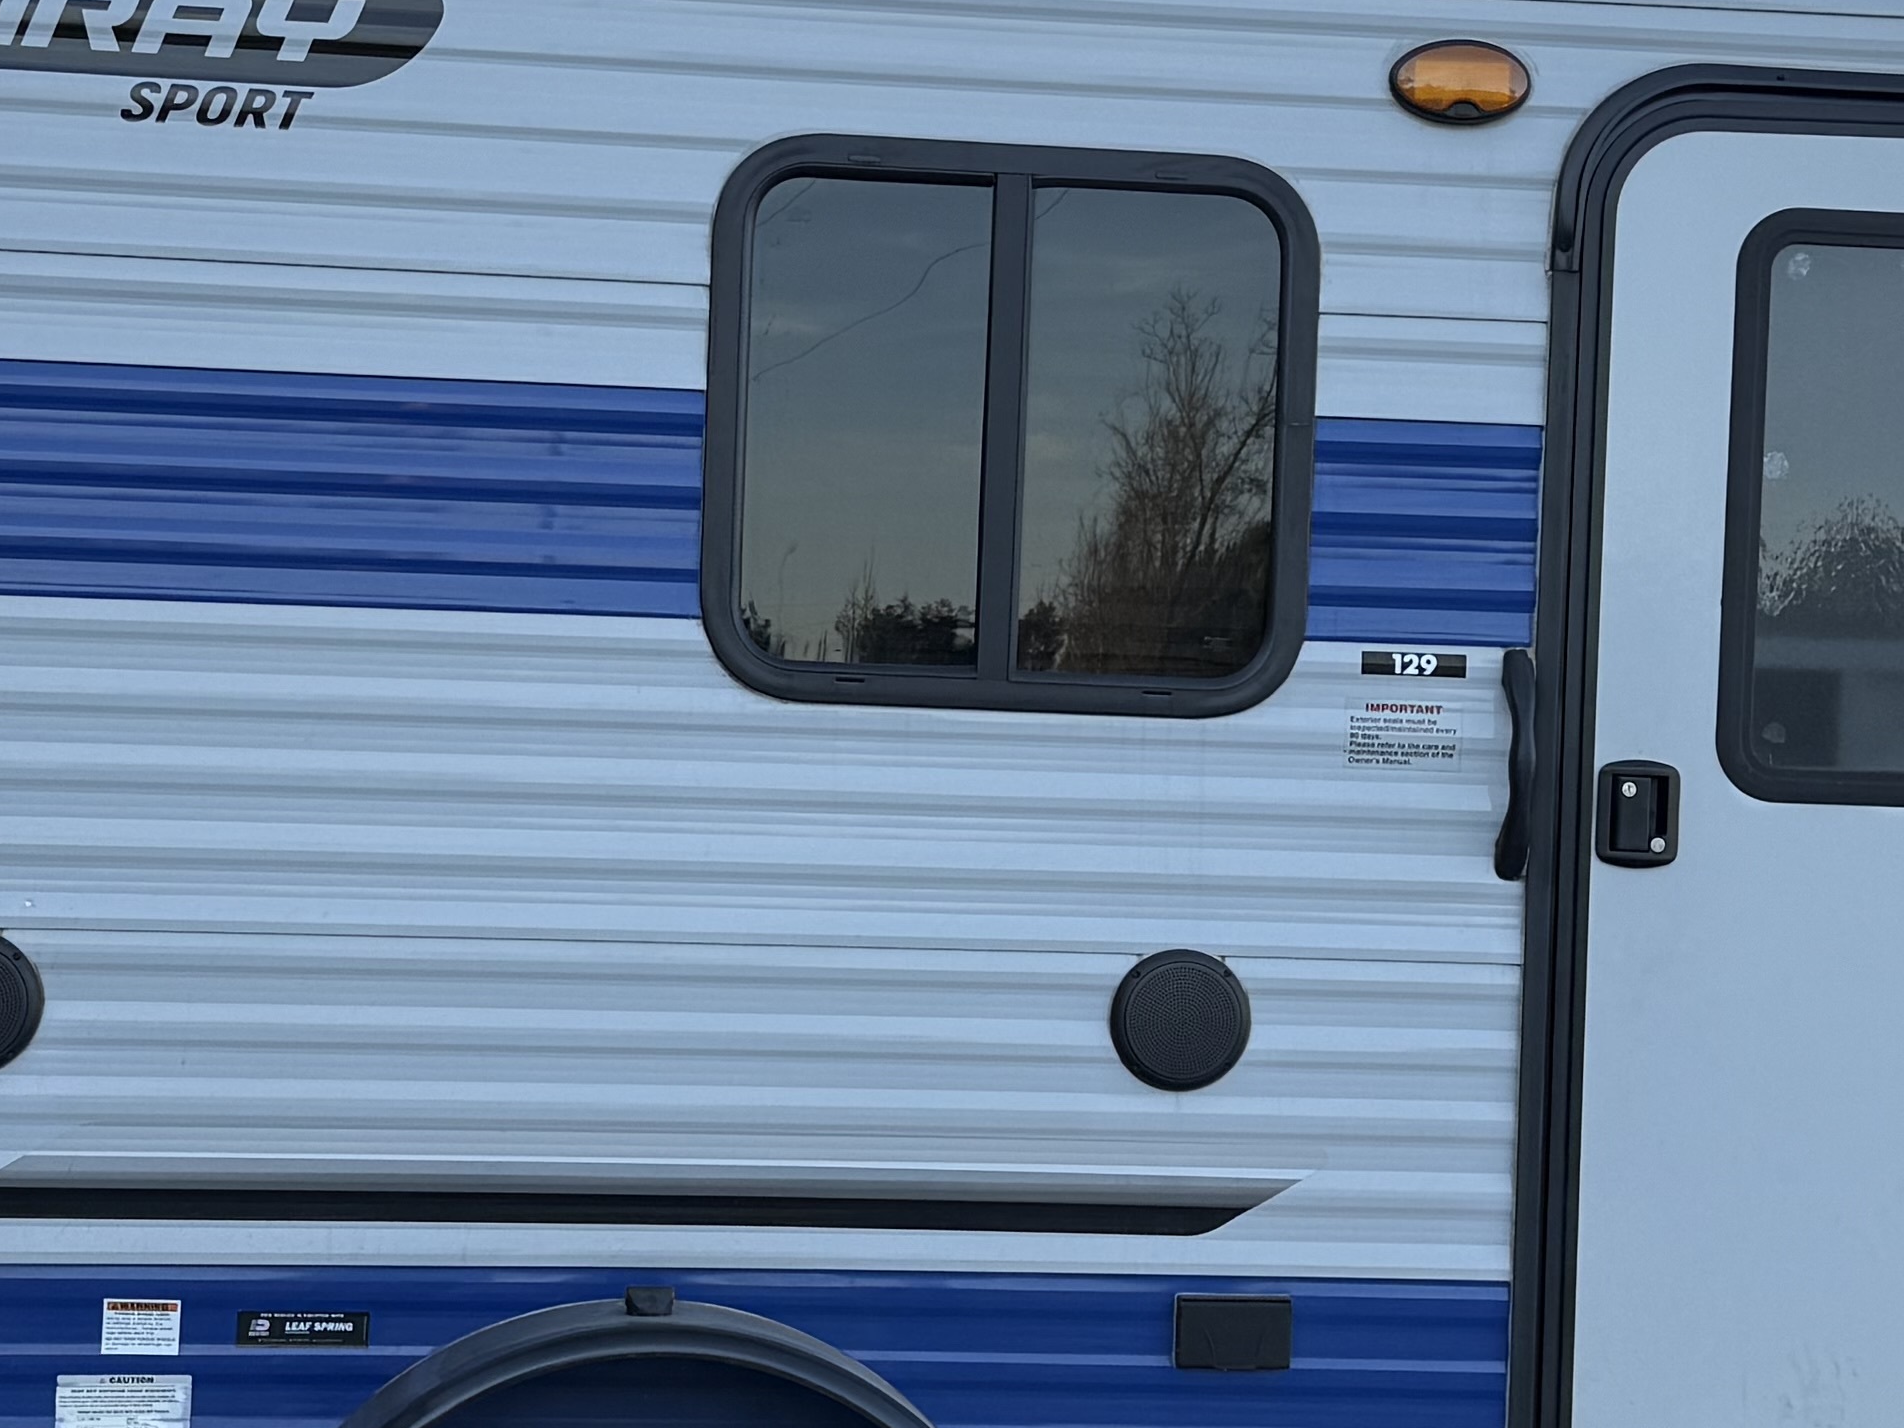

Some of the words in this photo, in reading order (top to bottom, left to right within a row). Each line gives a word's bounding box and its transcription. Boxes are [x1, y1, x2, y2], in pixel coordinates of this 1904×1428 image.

[121, 81, 314, 131] SPORT
[1392, 653, 1438, 675] 129
[1366, 703, 1443, 715] IMPORTANT
[1349, 740, 1375, 748] Please
[1349, 749, 1398, 757] maintenance
[1348, 756, 1380, 764] Owner's
[285, 1322, 312, 1331] LEAF
[314, 1323, 353, 1331] SPRING
